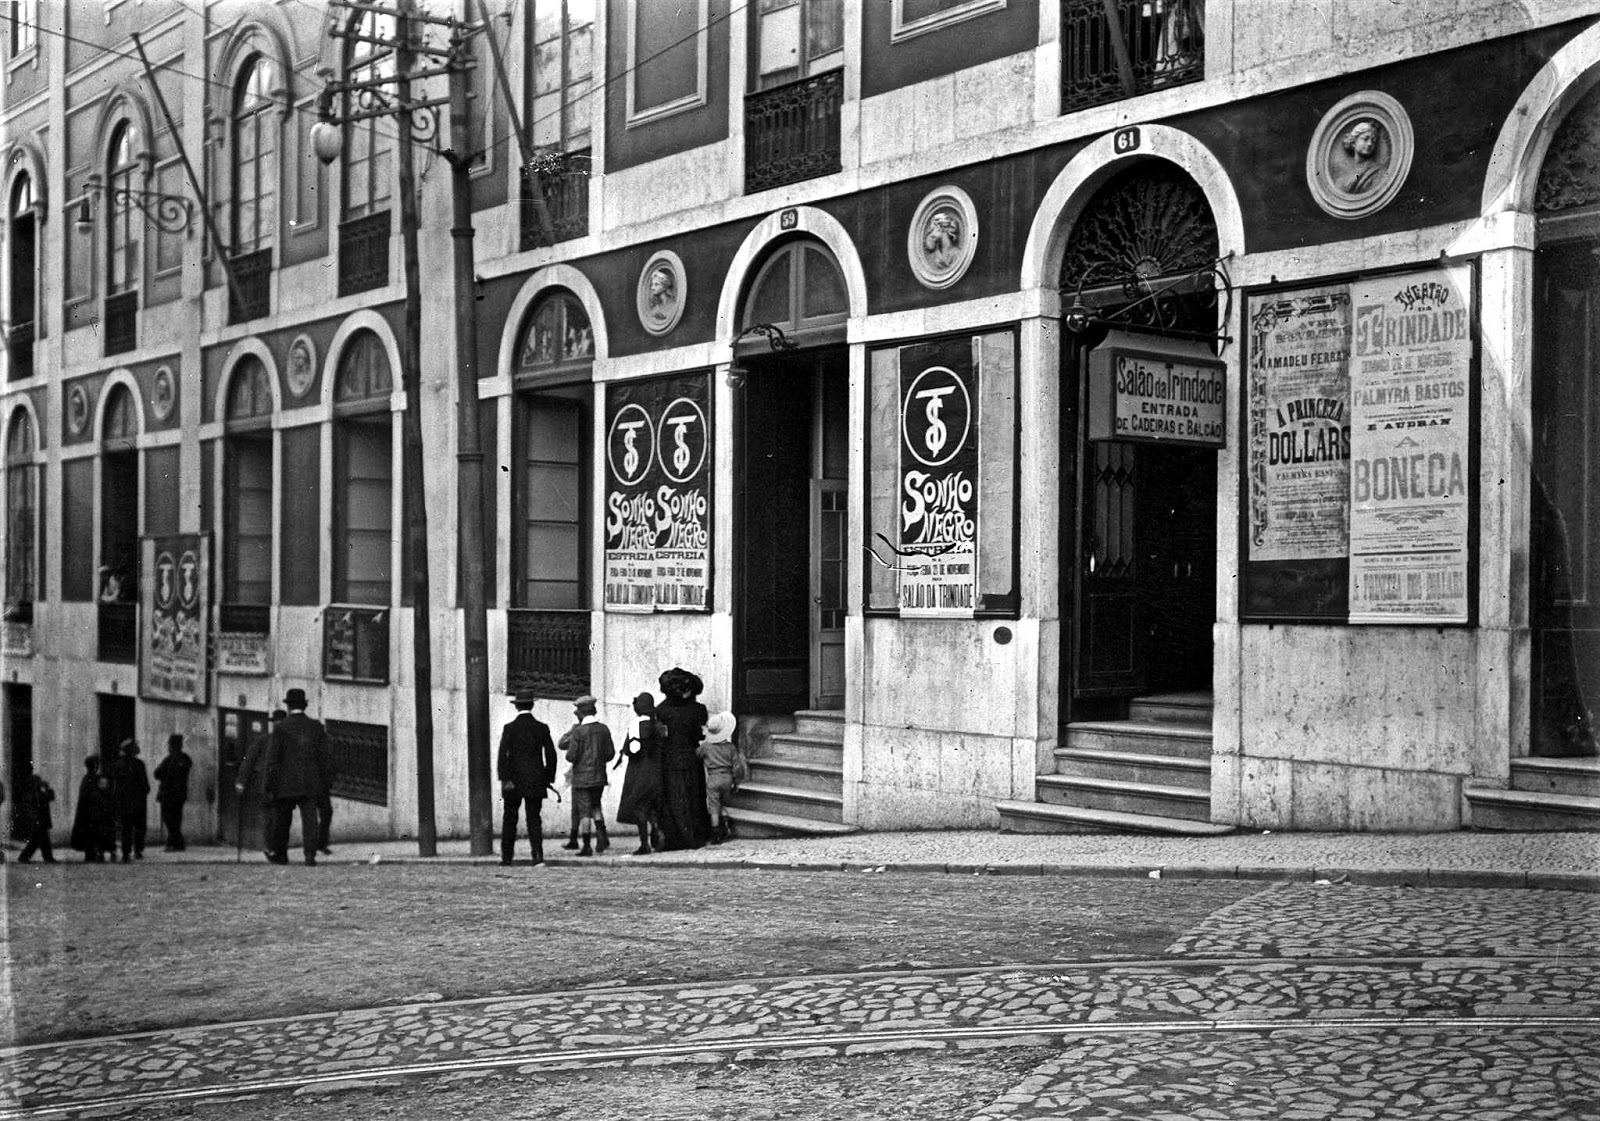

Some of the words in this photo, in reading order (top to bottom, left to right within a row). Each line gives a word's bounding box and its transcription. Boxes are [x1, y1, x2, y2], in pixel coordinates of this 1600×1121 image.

[1118, 131, 1134, 149] 61
[782, 211, 796, 227] 59
[1394, 282, 1449, 313] THEATRO
[1356, 304, 1467, 356] TRINDADE
[1267, 354, 1308, 369] AMADEU
[1117, 356, 1154, 398] Salão
[1155, 377, 1167, 399] da
[1165, 363, 1222, 404] Trindade
[1354, 385, 1410, 407] PALMYRA
[1416, 381, 1465, 401] BASTOS
[1141, 402, 1199, 418] ENTRADA
[1276, 408, 1287, 428] A
[1287, 398, 1344, 422] PRINCEZA
[1384, 418, 1451, 430] AUDRAN
[1116, 417, 1129, 430] DE
[1178, 423, 1185, 435] E
[1269, 425, 1351, 465] DOLLARS
[1354, 452, 1465, 502] BONECA
[655, 485, 707, 538] SONHO
[902, 470, 973, 533] SONHO
[606, 491, 655, 543] SONHO
[913, 507, 975, 543] NEGRO
[616, 521, 656, 550] NEGRO
[663, 518, 708, 549] NEGRO
[608, 552, 655, 561] ESTREIA
[655, 550, 706, 560] ESTREIA
[926, 584, 936, 609] DA
[939, 583, 974, 609] TRINDADE
